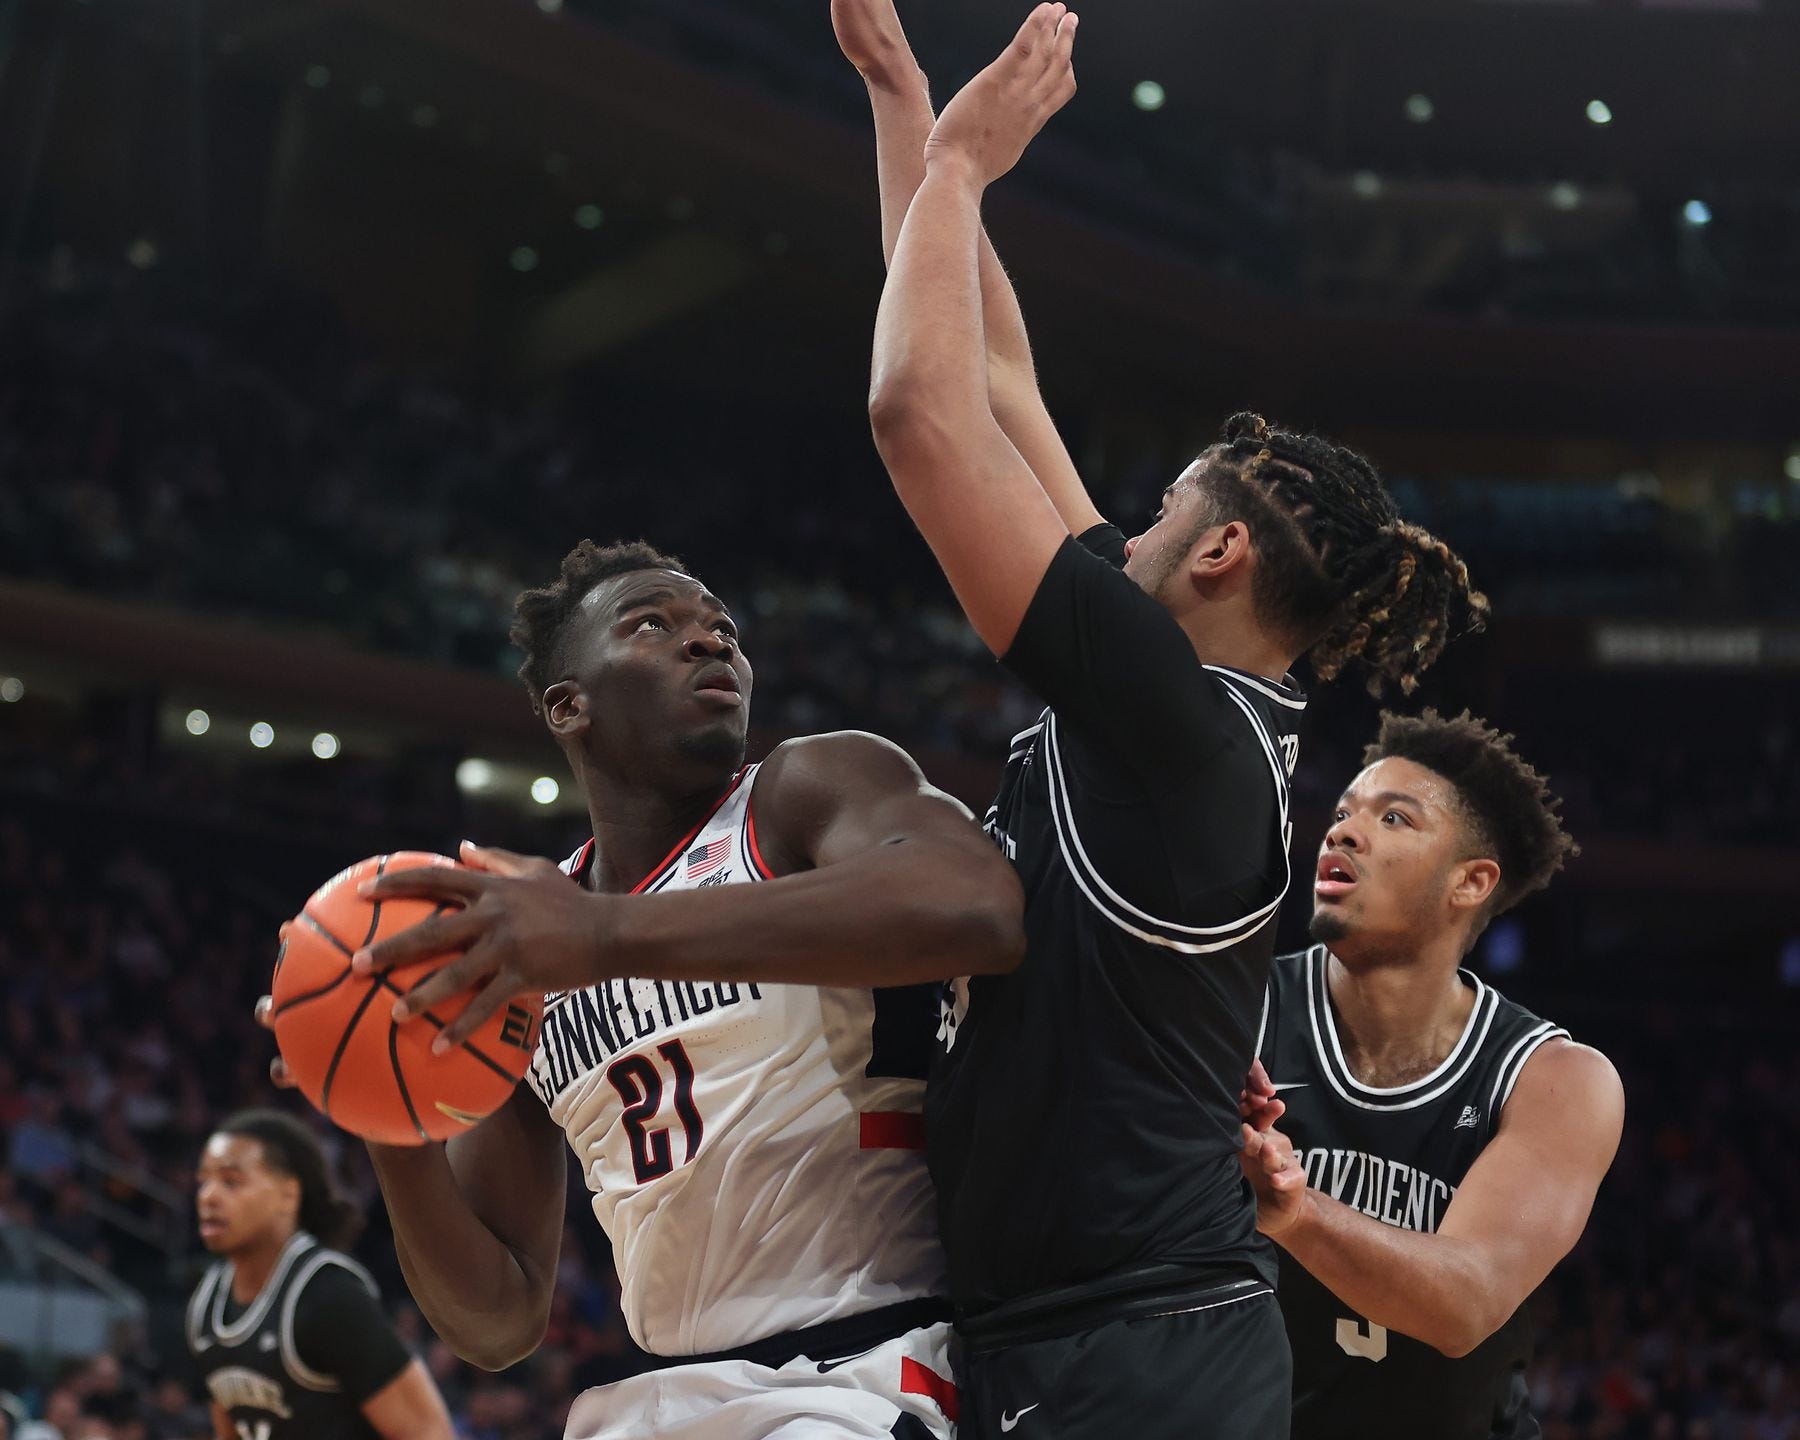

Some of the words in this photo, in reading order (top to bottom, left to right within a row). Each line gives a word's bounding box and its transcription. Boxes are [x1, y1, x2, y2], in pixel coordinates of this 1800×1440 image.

[531, 977, 762, 1109] CONNECT
[606, 1038, 704, 1185] 21
[1291, 1148, 1458, 1235] OVIDENC
